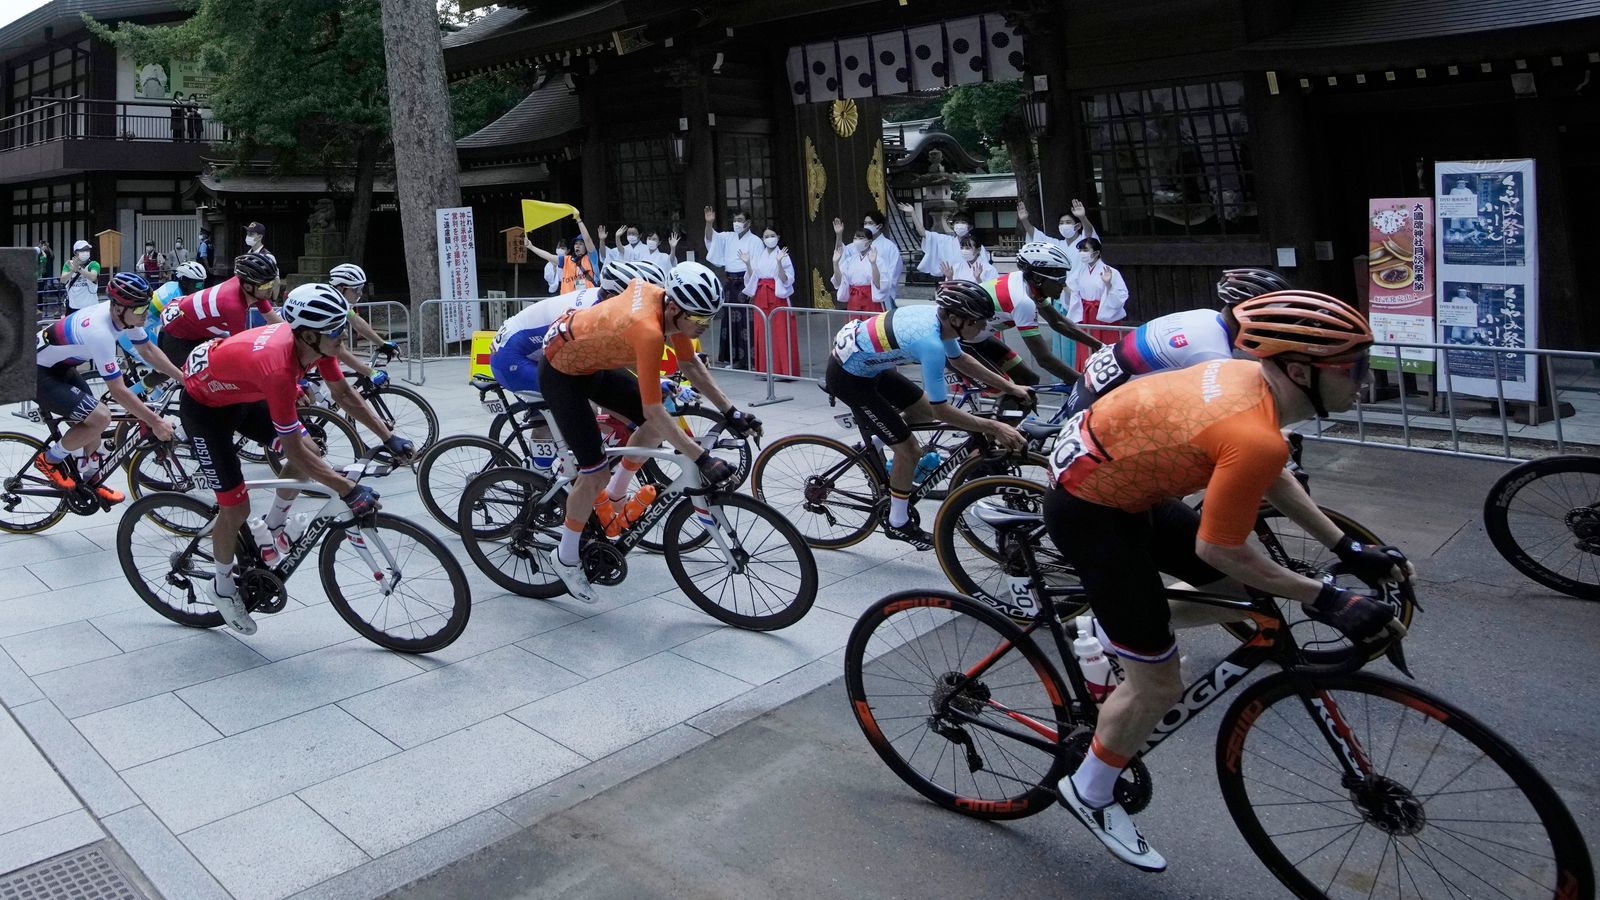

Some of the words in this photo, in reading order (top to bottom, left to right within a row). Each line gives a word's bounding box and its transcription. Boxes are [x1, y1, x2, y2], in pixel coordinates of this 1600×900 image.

[1093, 354, 1119, 385] 88
[27, 410, 41, 423] 89
[487, 403, 504, 414] 108
[98, 430, 142, 478] MERIDA
[193, 436, 210, 466] COSTA
[205, 465, 222, 490] RICA
[537, 444, 552, 456] 33
[916, 446, 970, 499] SPECIALIZED
[623, 491, 680, 547] PINARELLO
[1012, 583, 1034, 609] 30
